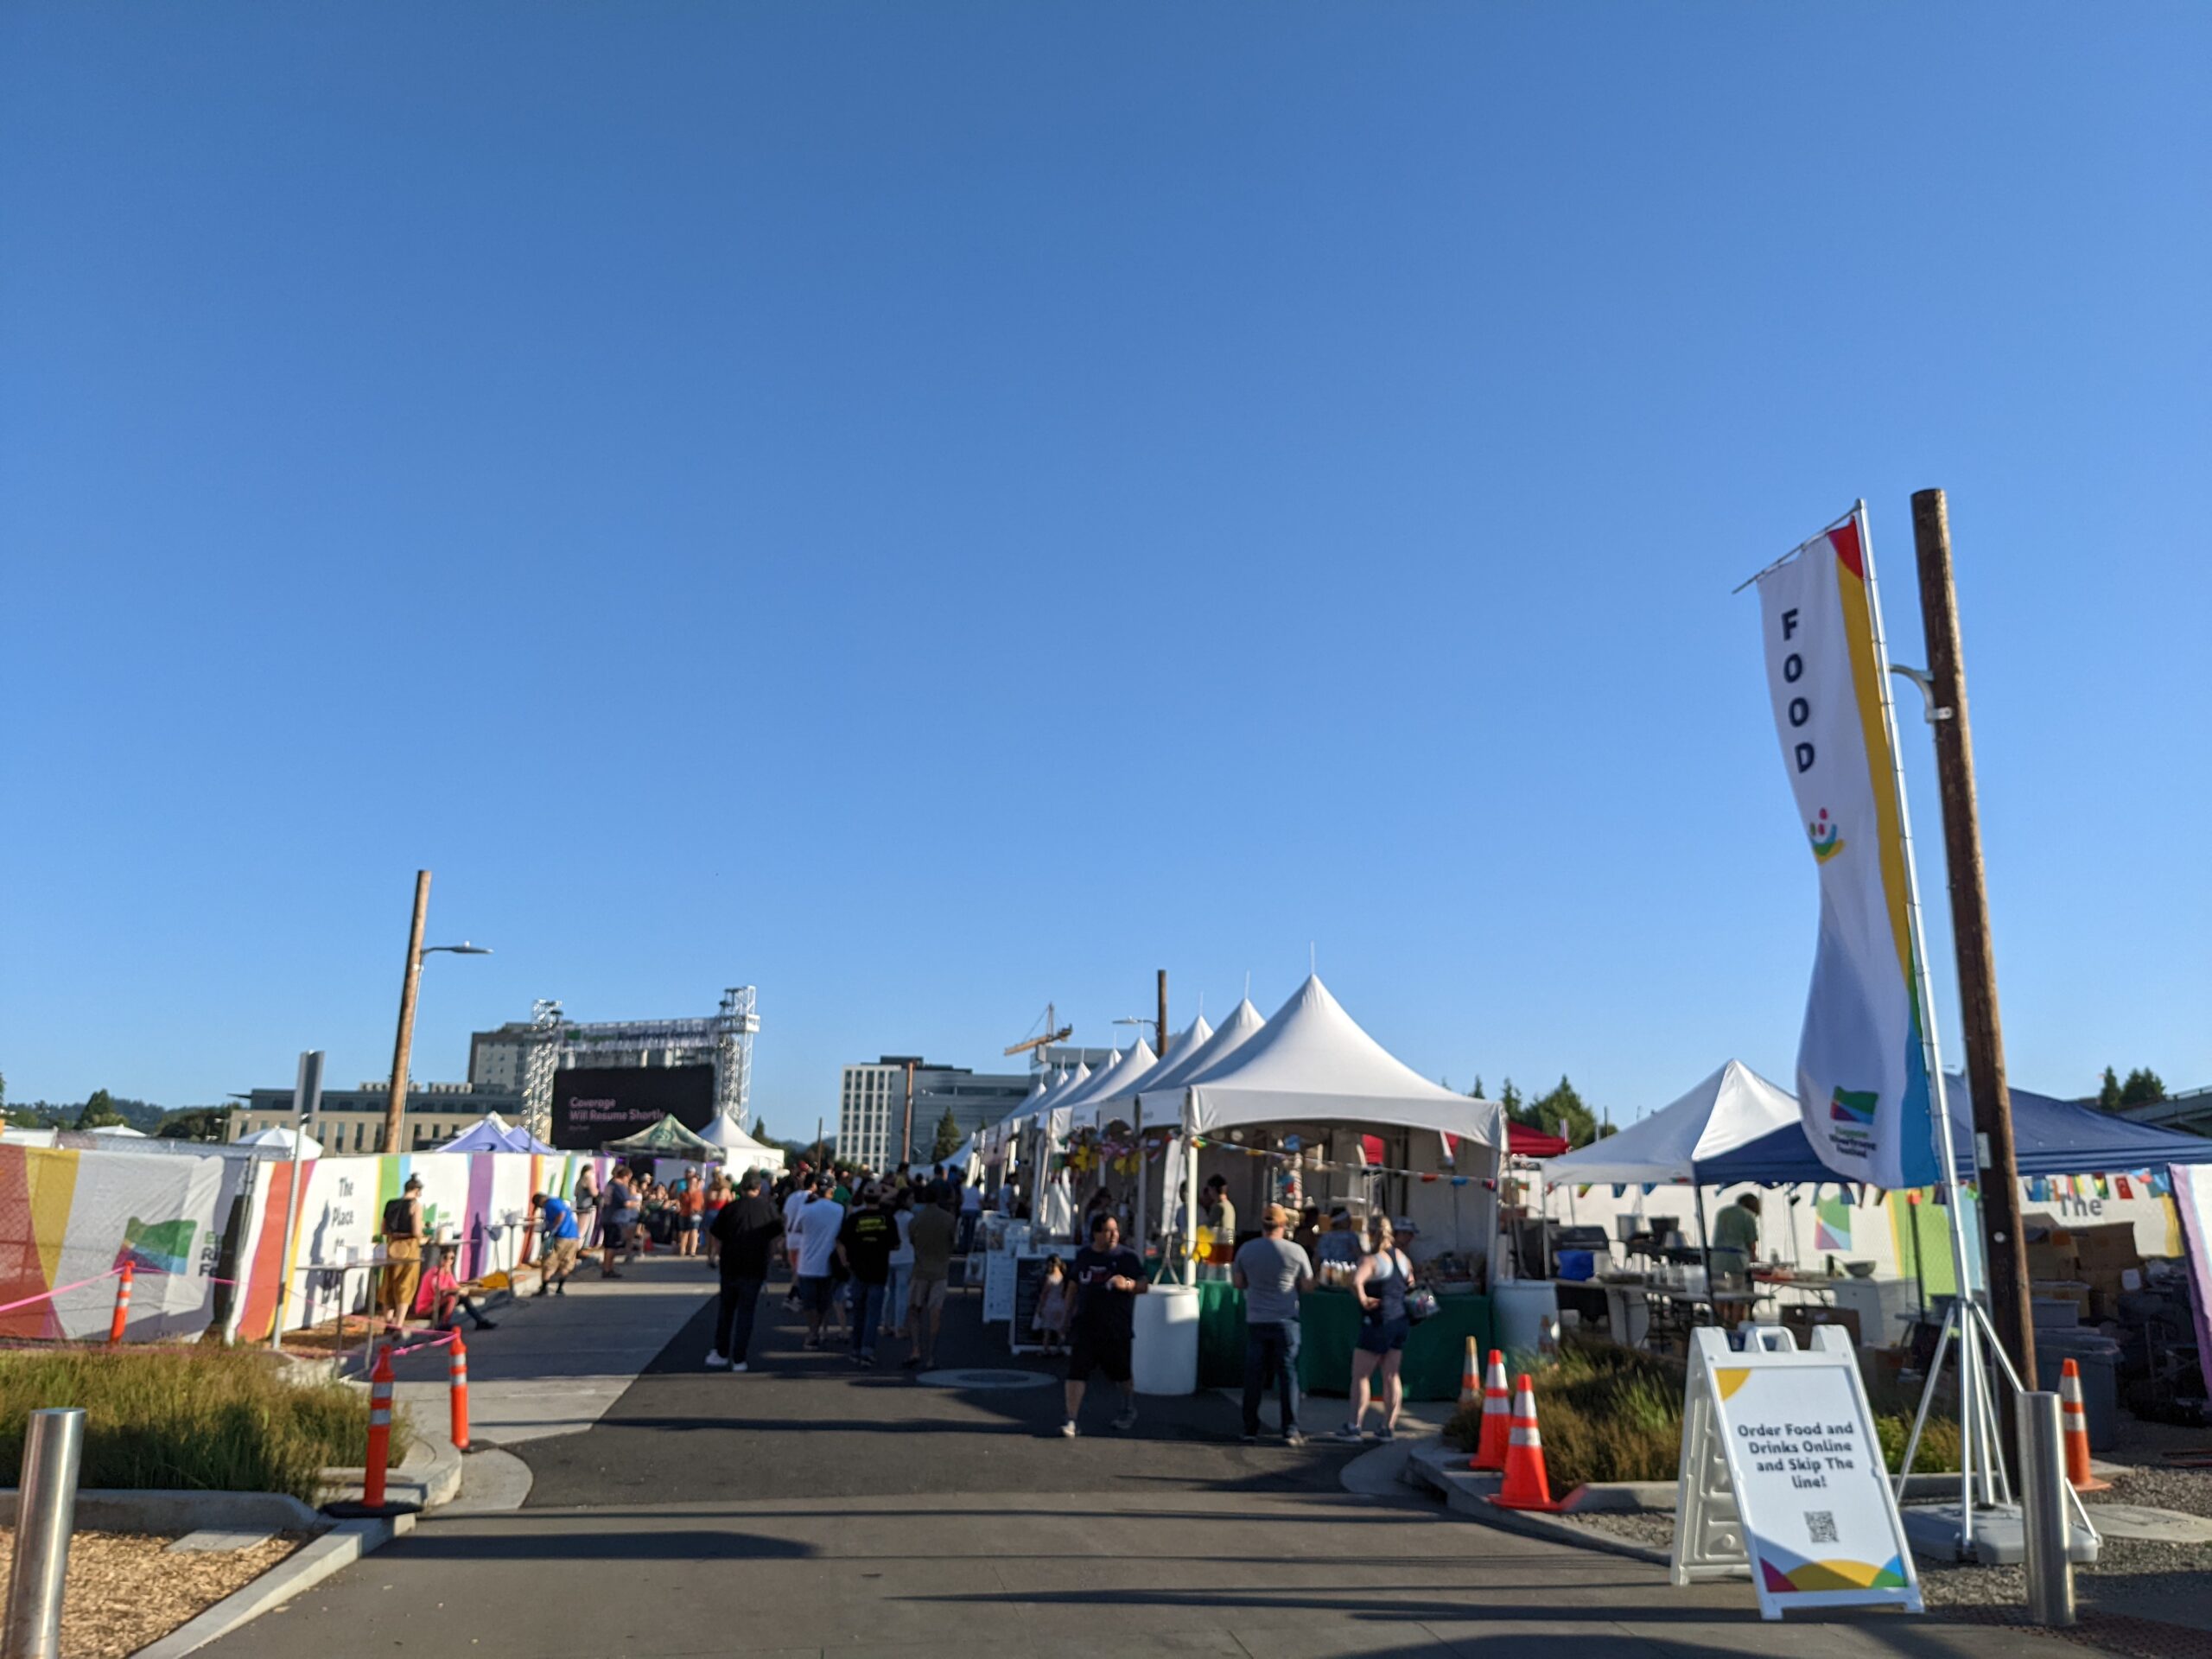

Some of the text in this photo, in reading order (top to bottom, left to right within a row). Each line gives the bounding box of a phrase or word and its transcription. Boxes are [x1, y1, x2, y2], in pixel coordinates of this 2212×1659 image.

[1781, 607, 1815, 773] FOOD
[569, 1096, 616, 1110] Coverage
[569, 1108, 665, 1122] Will Resume Shortly
[339, 1176, 353, 1198] The
[2059, 1192, 2102, 1217] The
[332, 1206, 354, 1228] Place
[1738, 1421, 1853, 1437] Order Food and
[1748, 1439, 1853, 1454] Drinks Online
[1757, 1456, 1854, 1474] and Skip The
